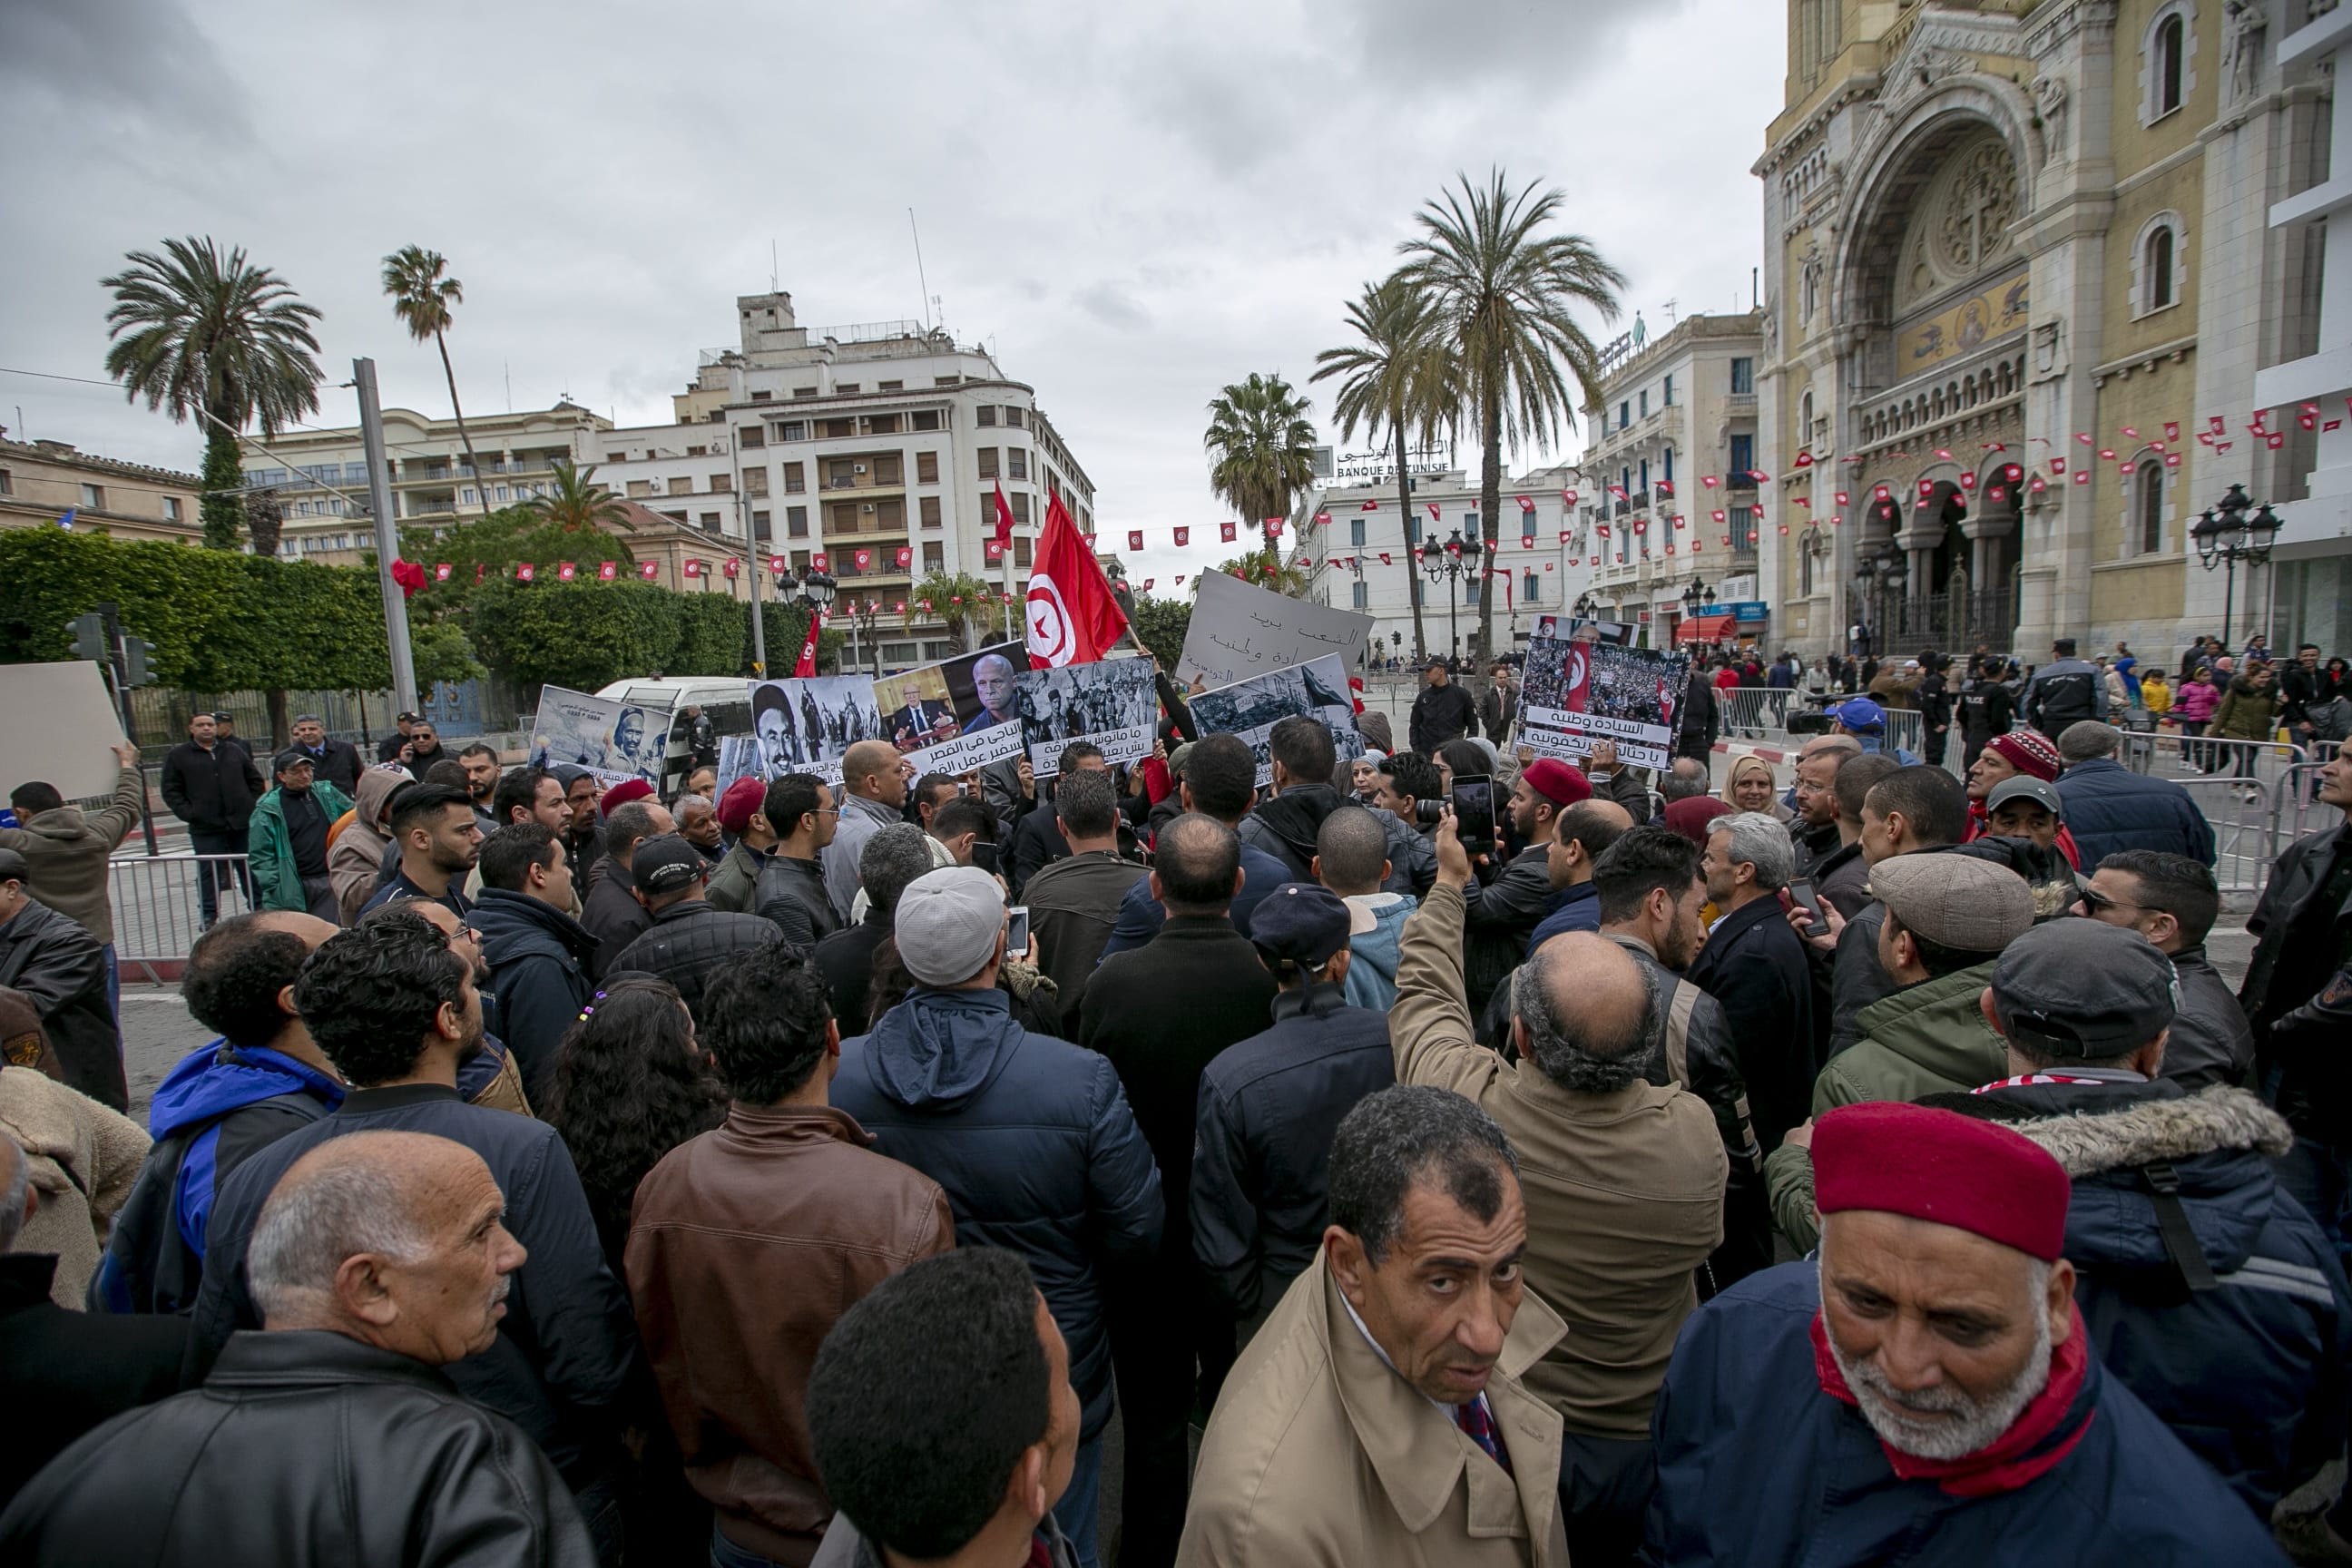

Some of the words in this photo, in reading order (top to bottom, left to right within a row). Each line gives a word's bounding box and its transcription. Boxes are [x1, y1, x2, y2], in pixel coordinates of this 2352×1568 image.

[1338, 465, 1384, 477] BANQUE
[1405, 463, 1448, 473] TUNISIE
[1551, 710, 1592, 729] وطنية
[1594, 717, 1644, 736] السيادة
[1130, 728, 1142, 739] ما
[929, 740, 964, 764] القصر
[957, 752, 986, 771] عمل
[1649, 750, 1660, 766] يا
